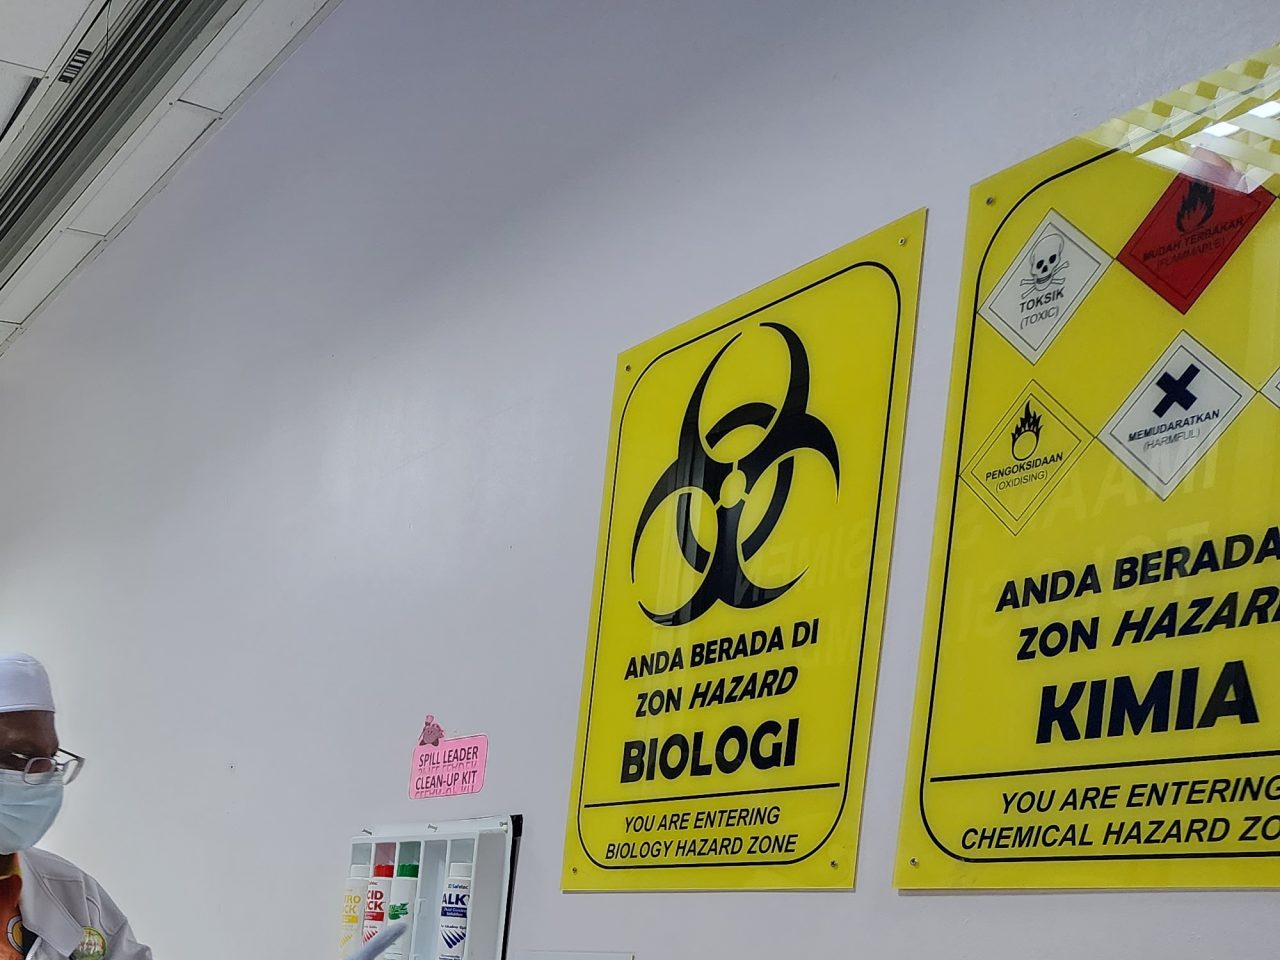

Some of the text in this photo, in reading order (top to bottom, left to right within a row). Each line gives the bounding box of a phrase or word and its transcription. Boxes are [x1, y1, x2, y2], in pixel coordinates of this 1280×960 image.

[1019, 286, 1065, 314] TOKSIK
[1020, 304, 1060, 330] (TOXIC)
[1128, 409, 1220, 443] MEMUDARATKAN
[984, 452, 1063, 481] PENGOKSIDAAN
[995, 468, 1048, 494] (OXIDISING)
[995, 526, 1280, 613] ANDA BERADA
[624, 618, 820, 680] ANDA BERADA DI
[1016, 617, 1100, 661] ZON
[635, 665, 799, 718] ZON HAZARD
[1035, 659, 1260, 745] KIMIA
[419, 746, 479, 767] SPILL LEADER
[620, 717, 800, 784] BIOLOGI
[416, 770, 477, 790] CLEAN-UP KIT
[1001, 789, 1056, 815] YOU
[1060, 786, 1120, 811] ARE
[624, 805, 780, 834] YOU ARE ENTERING
[961, 823, 1094, 850] CHEMICAL
[1102, 817, 1230, 846] HAZARD
[605, 834, 798, 860] BIOLOGY HAZARD ZONE
